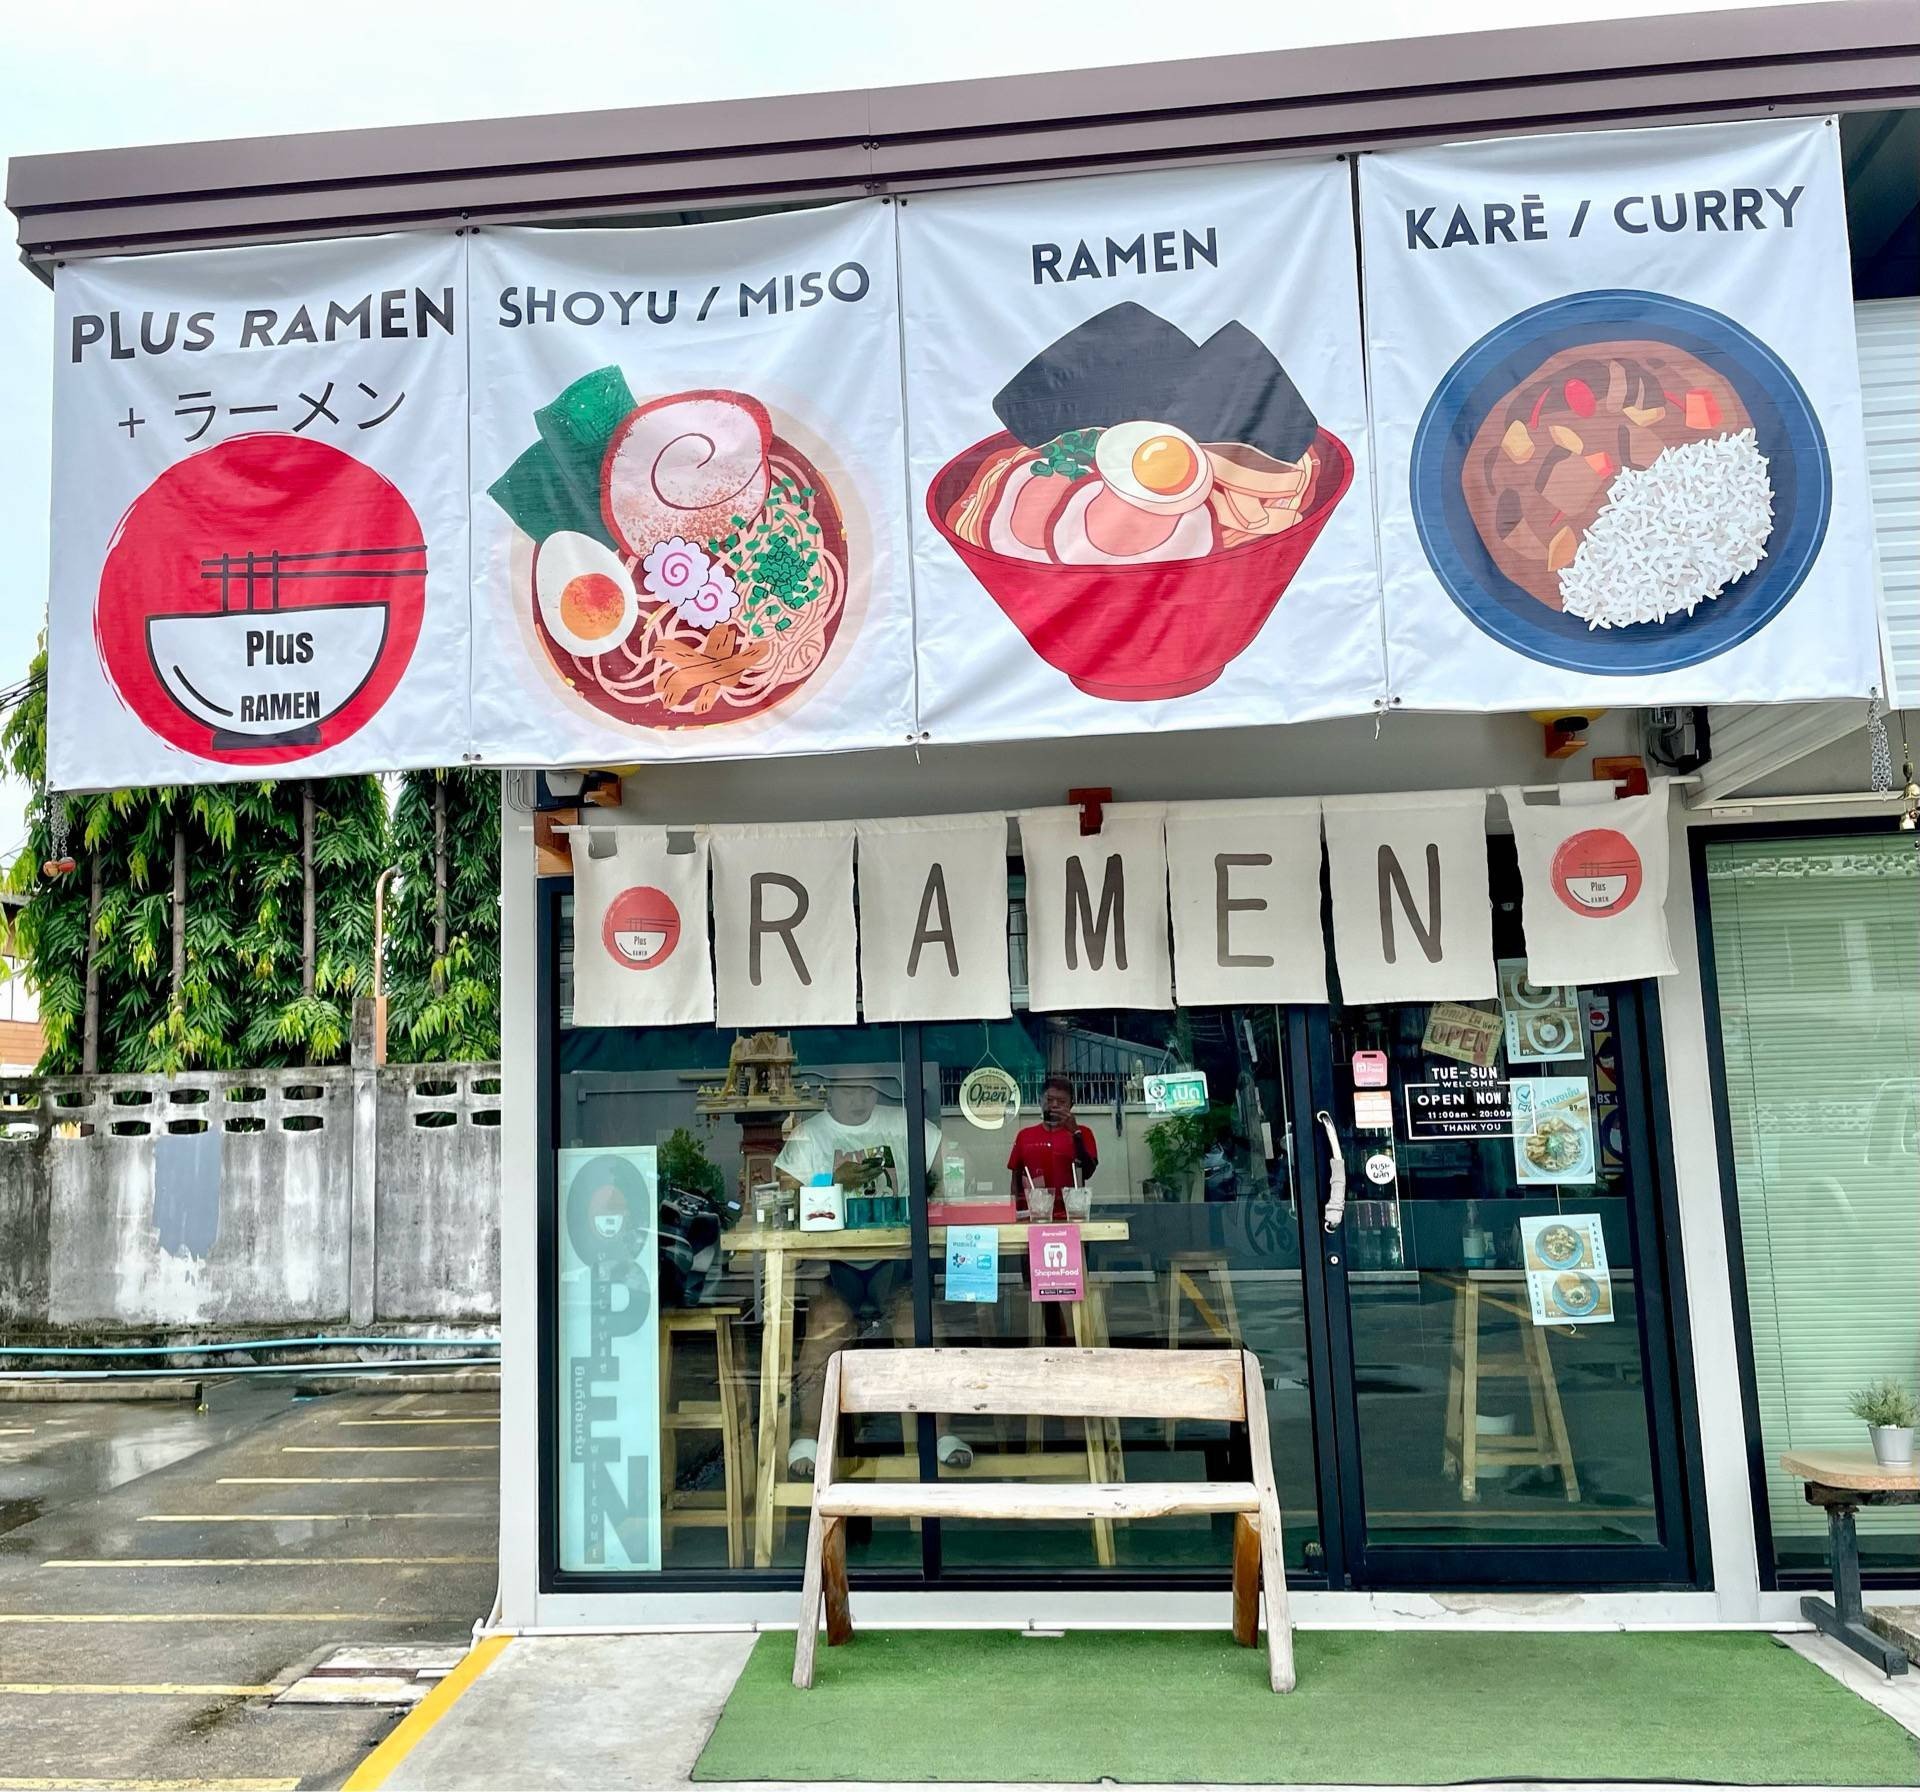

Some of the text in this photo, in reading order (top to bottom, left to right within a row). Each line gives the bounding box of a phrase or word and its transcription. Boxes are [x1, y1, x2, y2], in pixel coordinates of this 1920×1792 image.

[1405, 185, 1806, 250] KARĒ / CURRY
[1032, 227, 1220, 285] RAMEN
[498, 261, 871, 328] SHOYU / MISO
[71, 287, 455, 364] PLUS RAMEN
[174, 382, 406, 443] ラーメン
[246, 630, 314, 667] Plus
[240, 691, 321, 723] RAMEN
[633, 935, 647, 946] Plus
[1430, 1022, 1493, 1052] OPEN
[969, 1083, 1008, 1108] Open
[1172, 1084, 1200, 1101] เปิด
[1417, 1093, 1465, 1106] OPEN
[1476, 1092, 1502, 1105] NOW
[1442, 1080, 1495, 1088] WELCOME
[1442, 1122, 1502, 1132] THANK YOU
[567, 1154, 651, 1564] OPEN
[574, 1365, 587, 1457] ยินดีต้อนรับ
